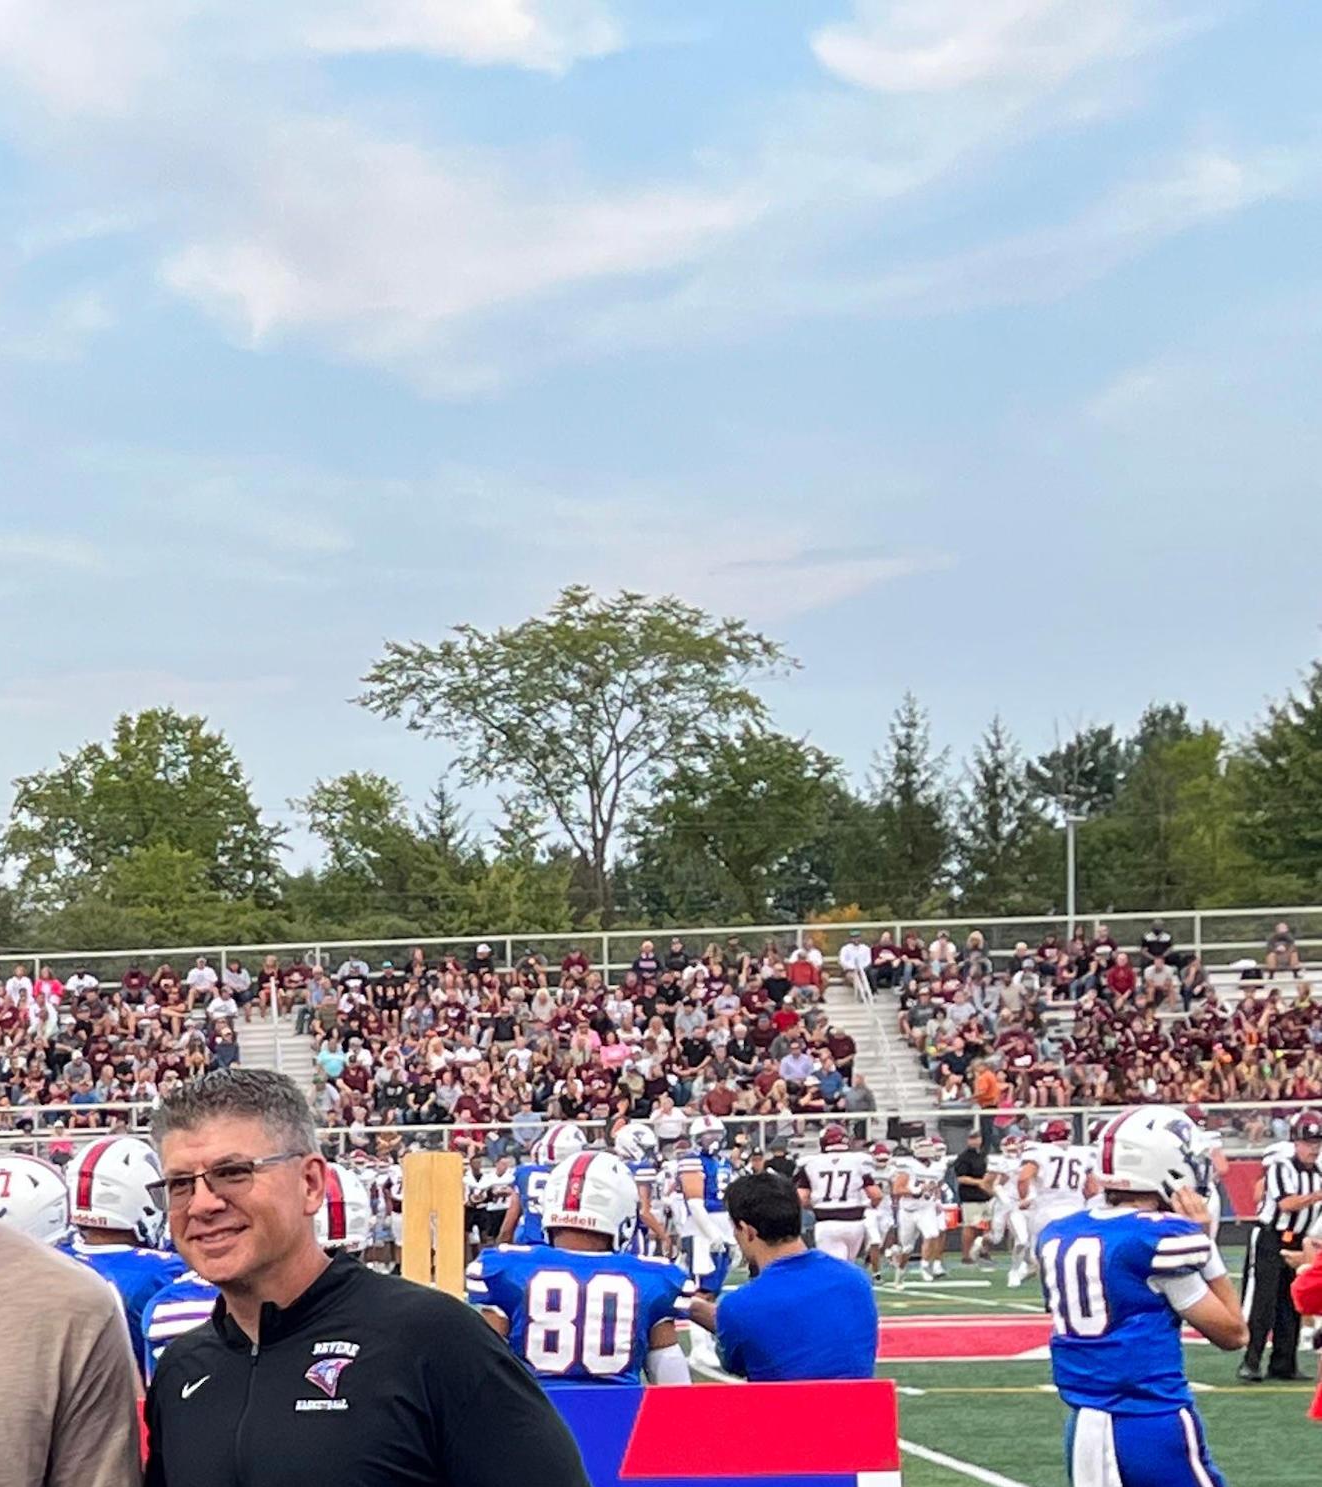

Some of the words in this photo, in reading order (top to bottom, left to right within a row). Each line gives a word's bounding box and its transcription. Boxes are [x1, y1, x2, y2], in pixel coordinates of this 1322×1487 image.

[818, 1169, 852, 1202] 77
[1049, 1156, 1082, 1190] 76
[1039, 1236, 1109, 1338] 10
[525, 1269, 637, 1375] 80
[311, 1340, 361, 1358] REVERE
